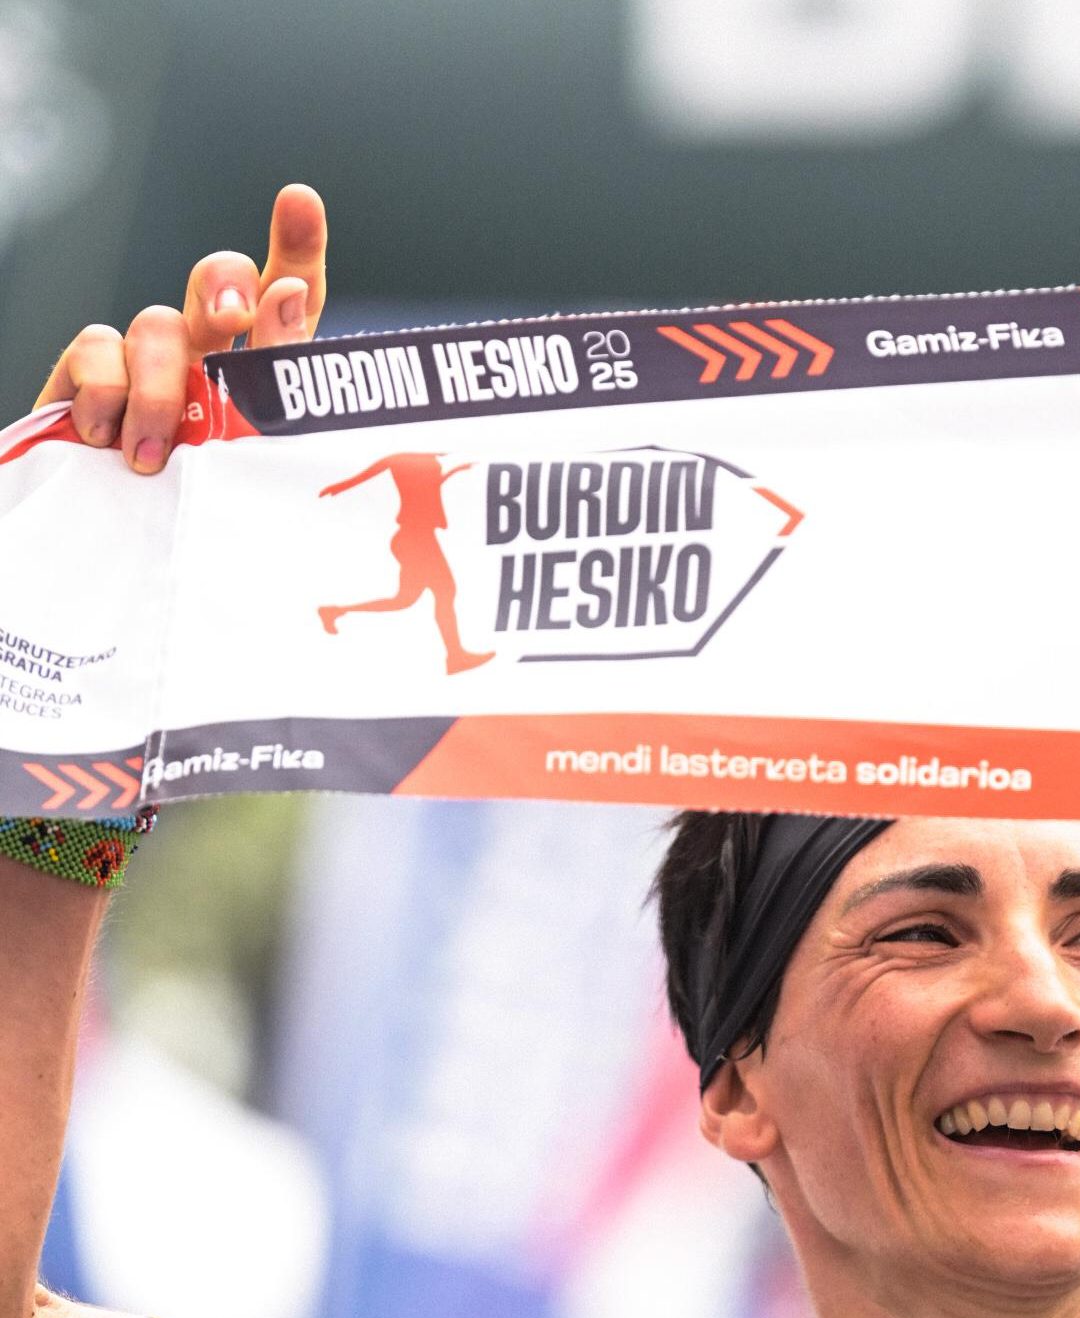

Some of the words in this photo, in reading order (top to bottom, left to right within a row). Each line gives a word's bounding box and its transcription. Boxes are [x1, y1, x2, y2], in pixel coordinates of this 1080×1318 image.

[432, 334, 580, 404] HESIKO
[583, 329, 632, 360] 20
[866, 321, 1066, 358] Gamiz-Fika
[272, 346, 430, 421] BURDIN
[589, 360, 639, 392] 25
[486, 460, 718, 546] BURDIN
[494, 543, 712, 632] HESIKO
[546, 744, 651, 774] mendi
[660, 746, 848, 784] lasterketa
[856, 756, 1032, 792] solidarioa
